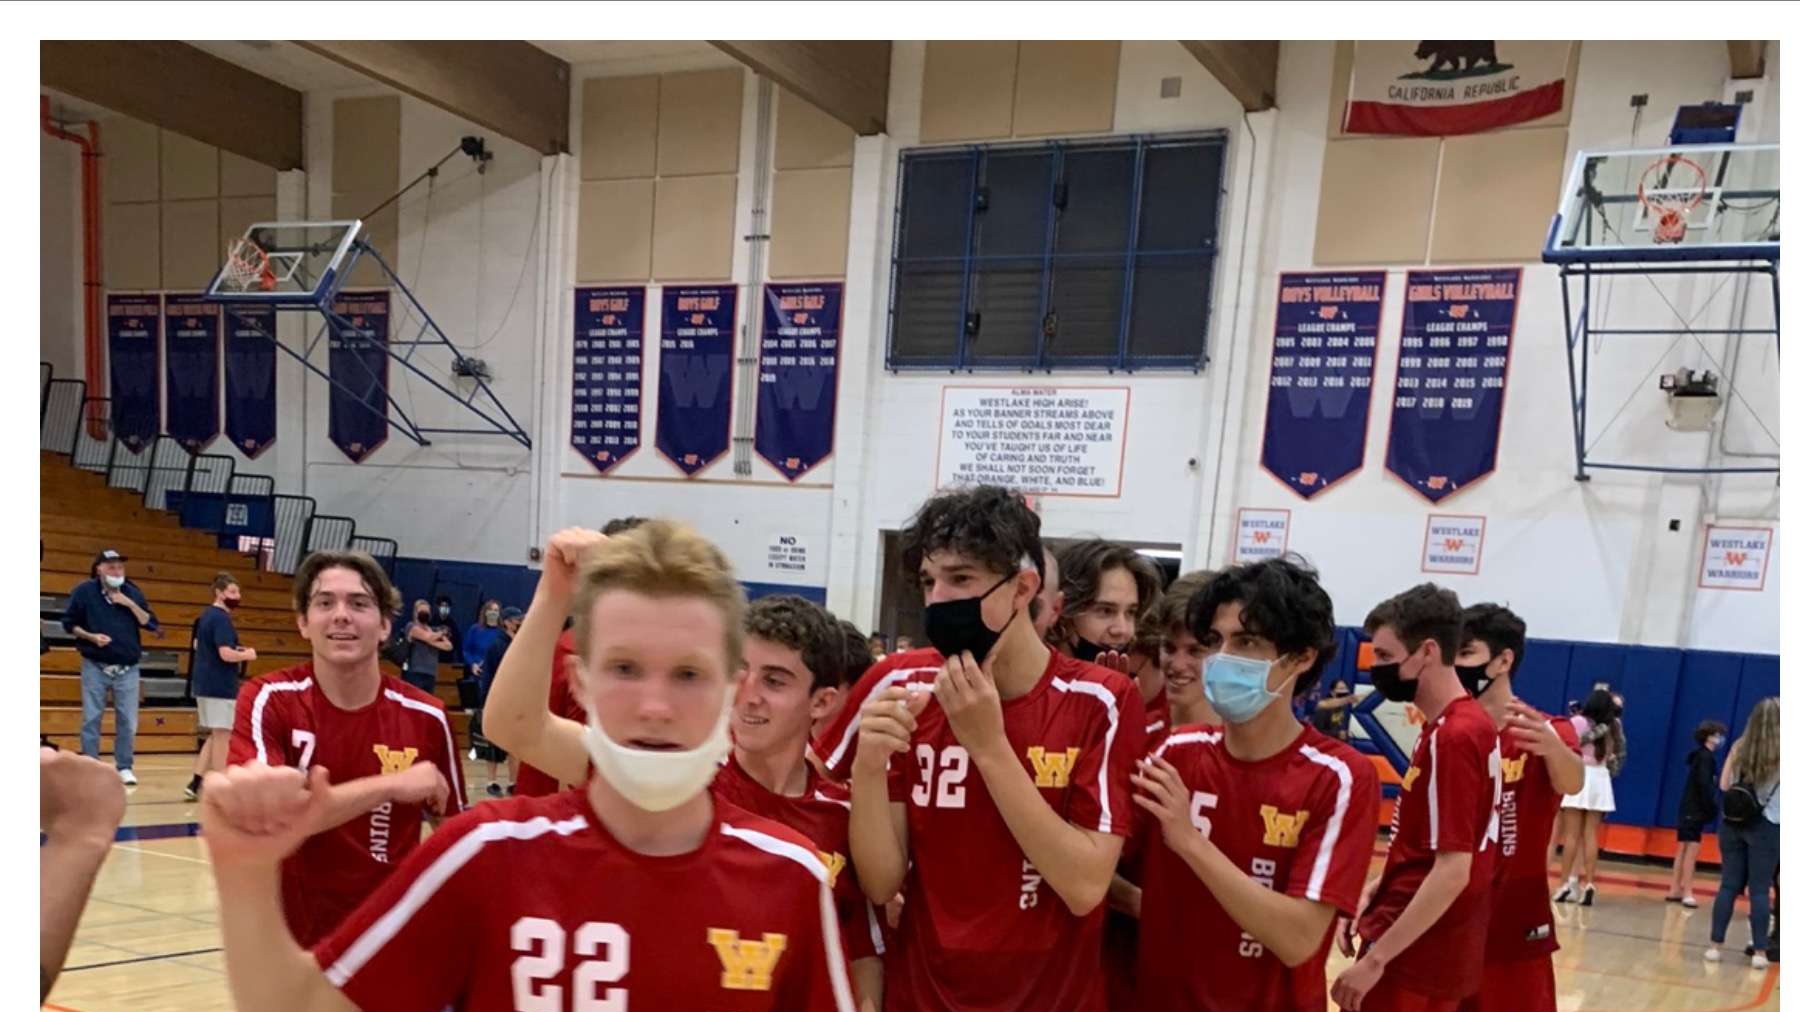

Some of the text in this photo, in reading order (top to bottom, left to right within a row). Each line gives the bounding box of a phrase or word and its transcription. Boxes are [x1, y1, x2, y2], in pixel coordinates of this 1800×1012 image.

[1389, 76, 1520, 100] CALIFORNIA REPUBLIC
[1282, 286, 1380, 303] BOYS VOLLEYBALL
[1409, 283, 1514, 301] GIRLS VOLLEYBALL
[1298, 322, 1356, 333] LEAGUE CHAMPS
[1426, 322, 1488, 333] LEAGUE CHAMPS
[980, 399, 1030, 407] WESTLAKE
[1033, 399, 1055, 408] HIGH
[953, 409, 1114, 419] AS YOUR BANNER STREAMS ABOVE
[955, 420, 1111, 431] AND TELLS OF GOALS MOST DEAR
[952, 431, 1112, 442] TO YOUR STUDENTS FAR AND NEAR
[965, 442, 1088, 453] YOU'VE TAUGHT US OF LIFE
[976, 453, 1080, 463] OF CARING AND TRUTH
[960, 463, 1095, 475] WE SHALL NOT SOON FORGET
[953, 473, 975, 481] THAT
[1056, 475, 1075, 486] AND
[1242, 520, 1285, 528] WESTLAKE
[1254, 531, 1270, 543] W
[1432, 527, 1479, 536] WESTLAKE
[780, 536, 796, 545] NO
[1445, 538, 1464, 551] W
[1710, 540, 1764, 549] WESTLAKE
[1726, 552, 1748, 565] W
[292, 729, 316, 778] 7
[1027, 746, 1080, 787] W
[911, 743, 969, 808] 32
[1259, 804, 1309, 848] W
[369, 802, 392, 864] RUINS
[707, 927, 788, 991] W
